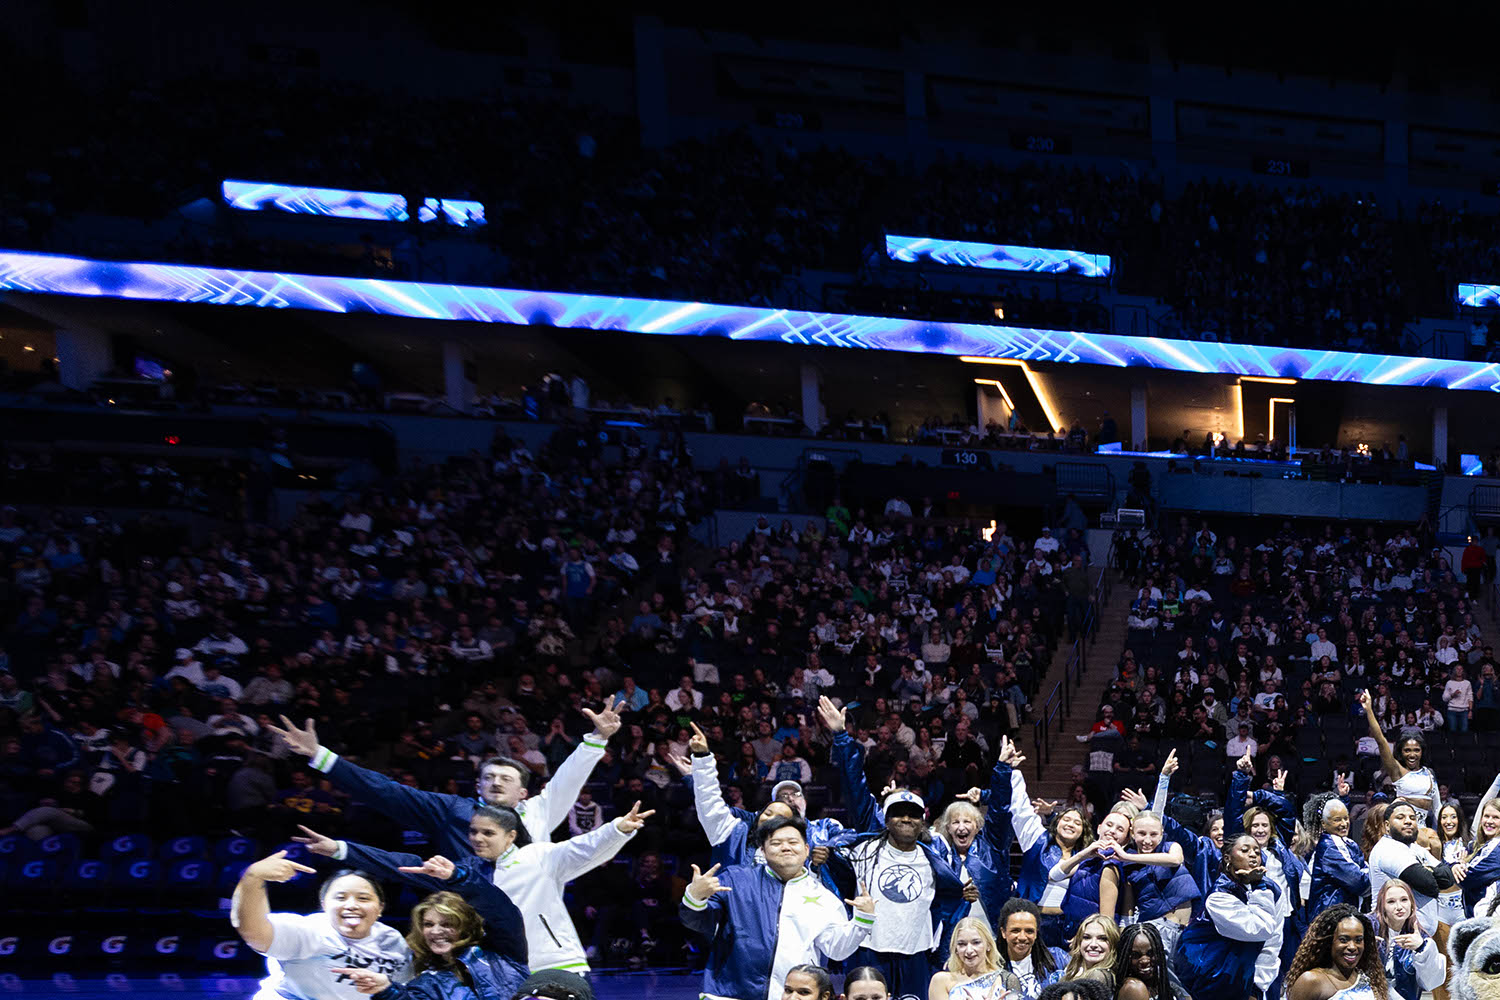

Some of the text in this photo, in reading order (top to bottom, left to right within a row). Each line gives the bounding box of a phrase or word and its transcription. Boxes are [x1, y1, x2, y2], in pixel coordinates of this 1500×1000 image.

[953, 452, 977, 465] 130
[48, 936, 73, 955] G
[101, 936, 128, 954] G
[155, 936, 180, 954] G
[213, 940, 240, 959] G
